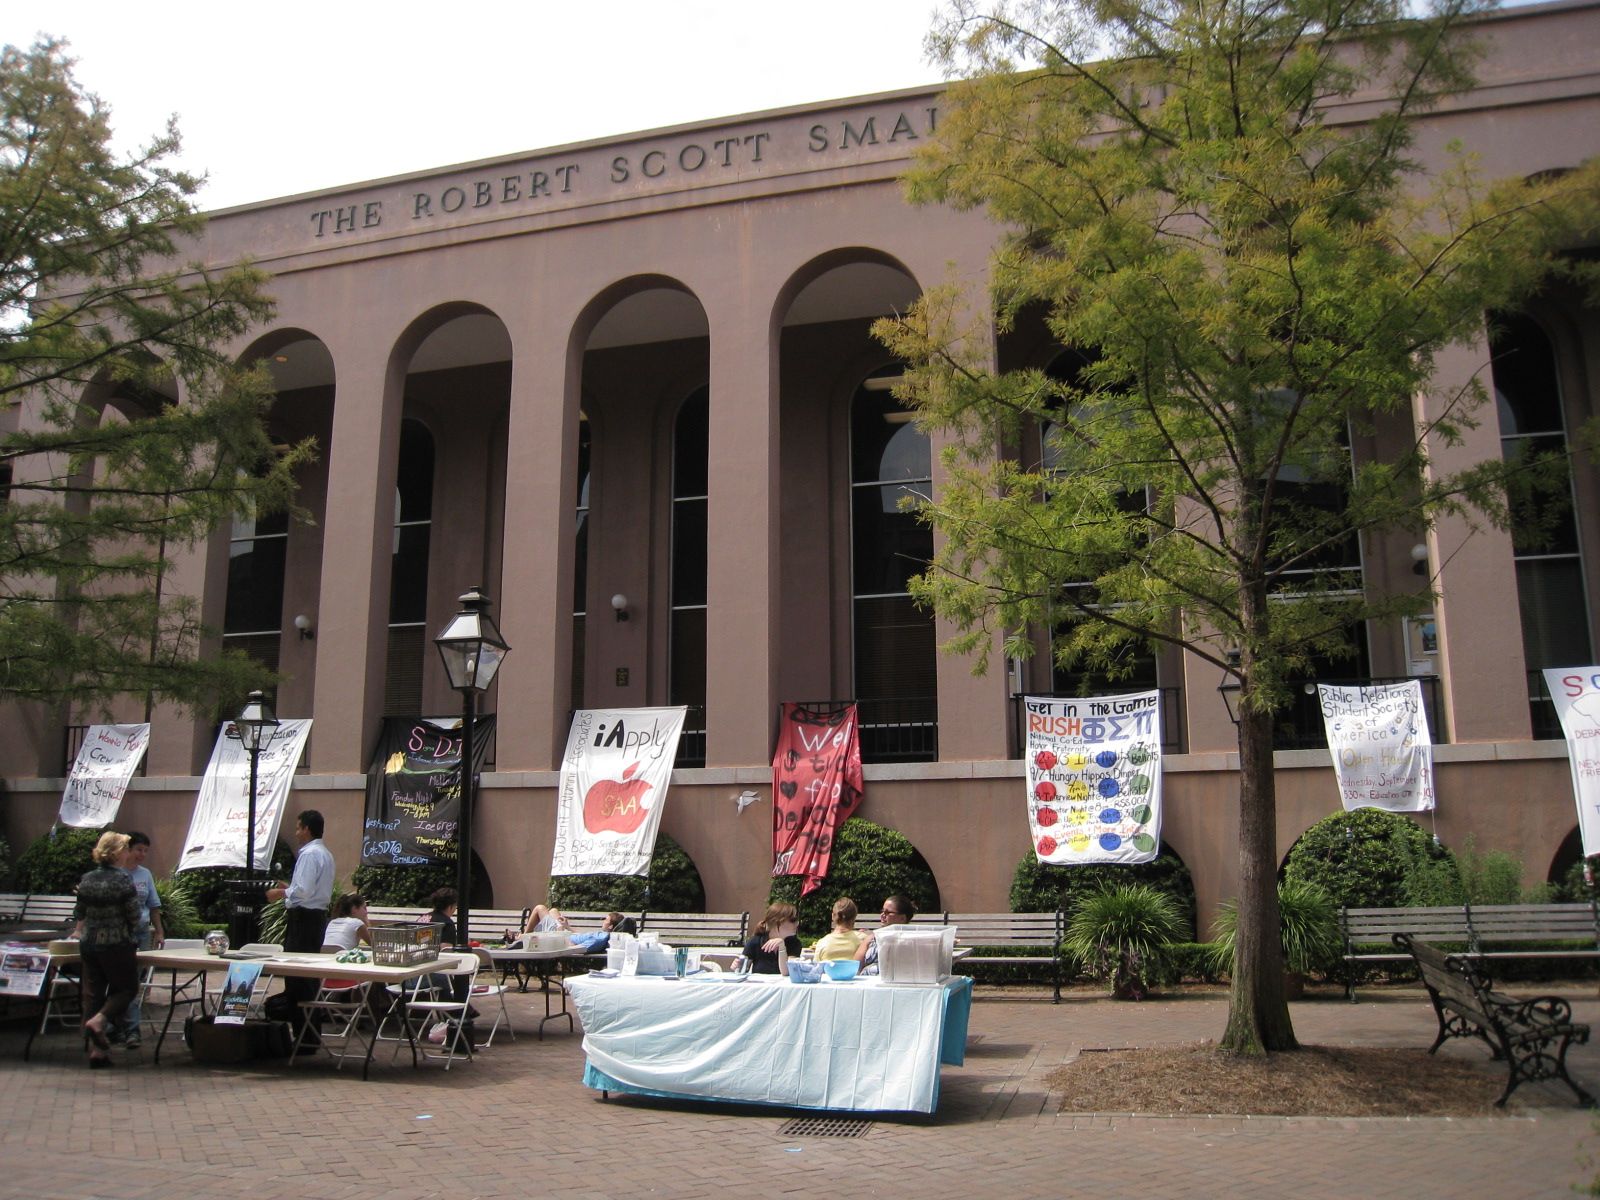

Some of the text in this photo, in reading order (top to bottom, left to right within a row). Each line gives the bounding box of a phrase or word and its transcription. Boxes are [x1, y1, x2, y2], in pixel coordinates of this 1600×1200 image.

[311, 201, 383, 238] THE
[411, 164, 580, 219] ROBERT
[610, 132, 770, 183] SCOTT
[1319, 685, 1412, 703] Public Relations
[1063, 703, 1078, 717] in
[1089, 702, 1111, 716] the
[1113, 696, 1158, 715] Game
[1322, 699, 1418, 718] Student Society
[1028, 714, 1081, 736] RUSH
[593, 717, 670, 760] iApply
[1029, 733, 1057, 743] National
